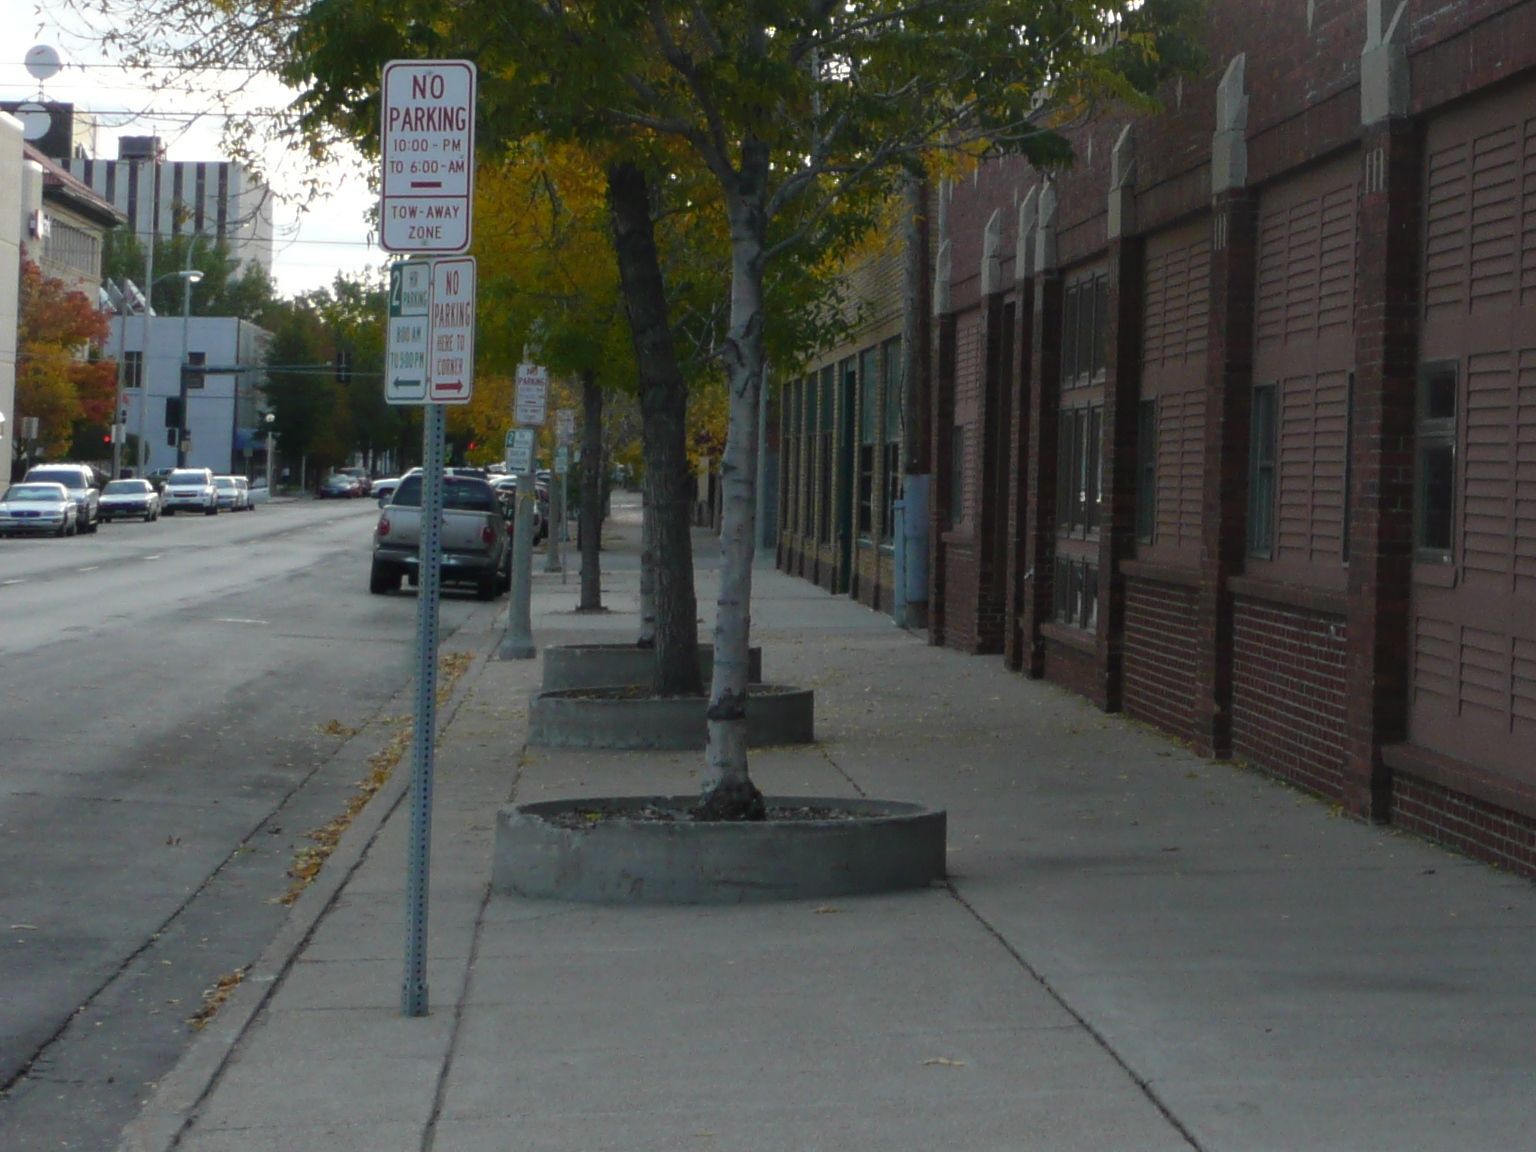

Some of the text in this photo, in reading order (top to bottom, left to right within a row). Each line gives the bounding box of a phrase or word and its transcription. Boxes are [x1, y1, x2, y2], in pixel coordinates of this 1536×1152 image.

[412, 74, 445, 100] NO
[389, 106, 467, 133] PARKING
[394, 138, 429, 153] 10:00
[389, 160, 404, 174] TO
[391, 205, 460, 219] TOW-AWAY
[408, 225, 442, 239] ZONE
[392, 270, 401, 306] 2
[446, 270, 460, 296] NO
[402, 290, 428, 307] PARKING
[433, 301, 471, 328] PARKING
[437, 334, 466, 352] HERE TO
[437, 357, 464, 376] CORNER
